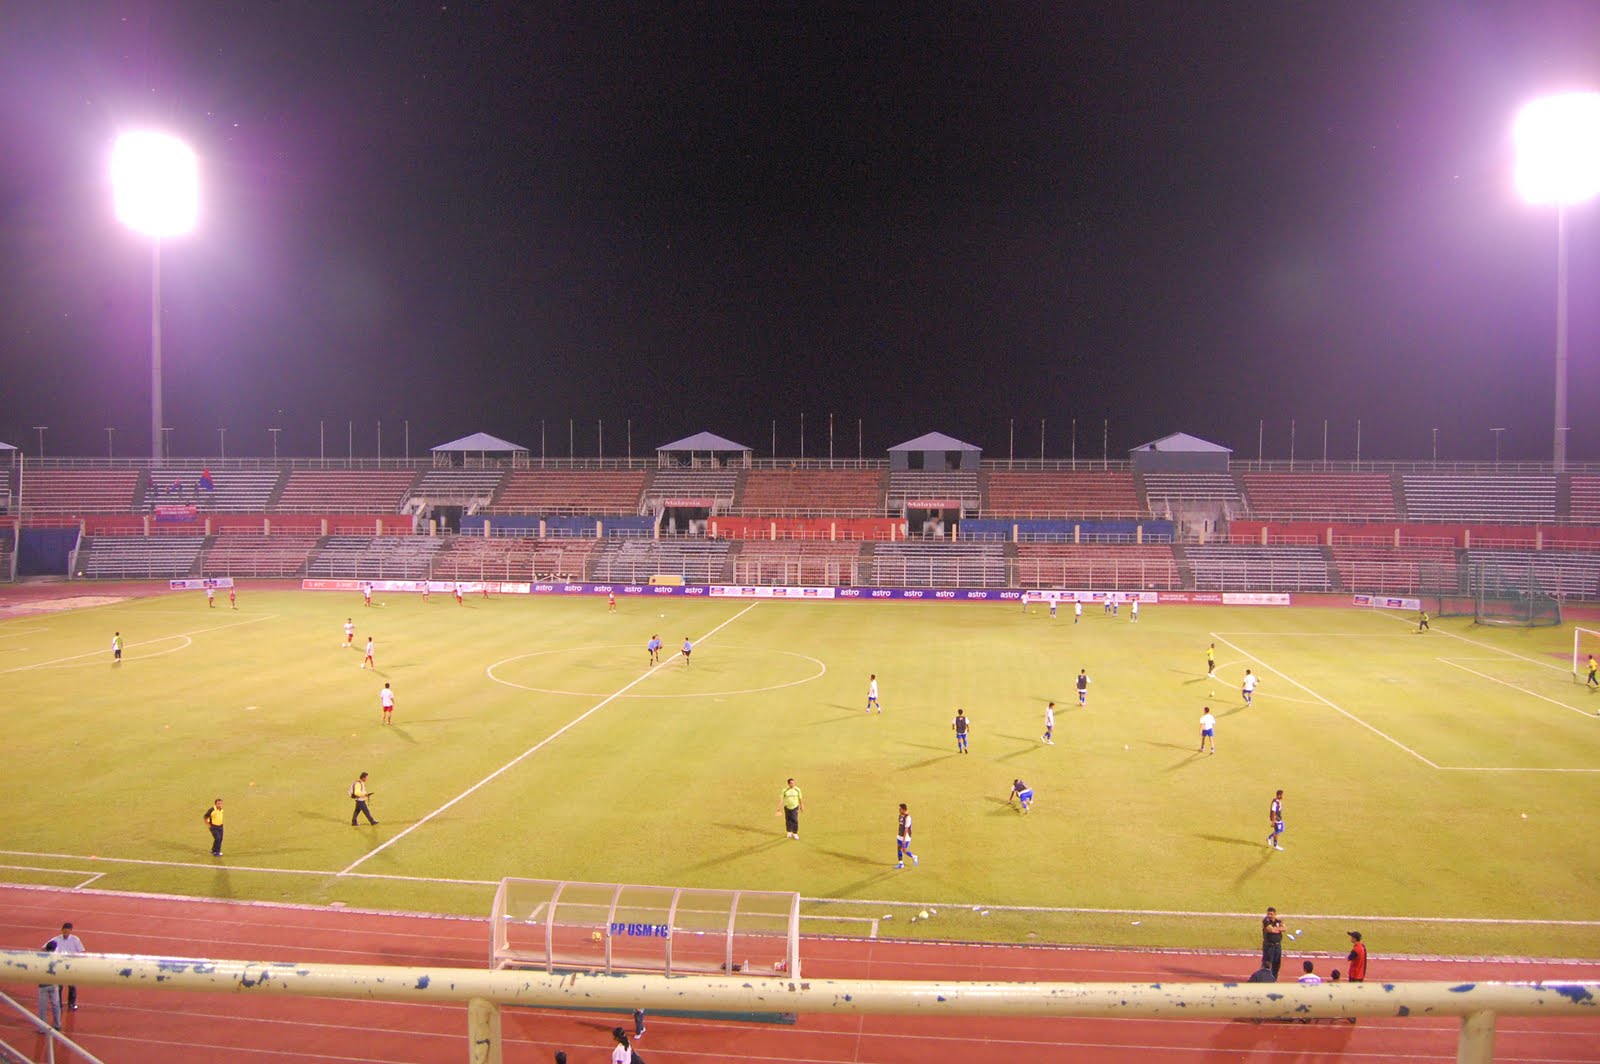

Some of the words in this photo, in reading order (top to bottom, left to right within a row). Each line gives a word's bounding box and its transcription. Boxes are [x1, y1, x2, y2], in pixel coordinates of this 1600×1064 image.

[664, 500, 701, 508] Malaysia
[564, 584, 582, 592] astro
[935, 590, 955, 598] astro
[1000, 591, 1020, 599] astro
[628, 923, 653, 936] USM
[655, 925, 668, 938] FC
